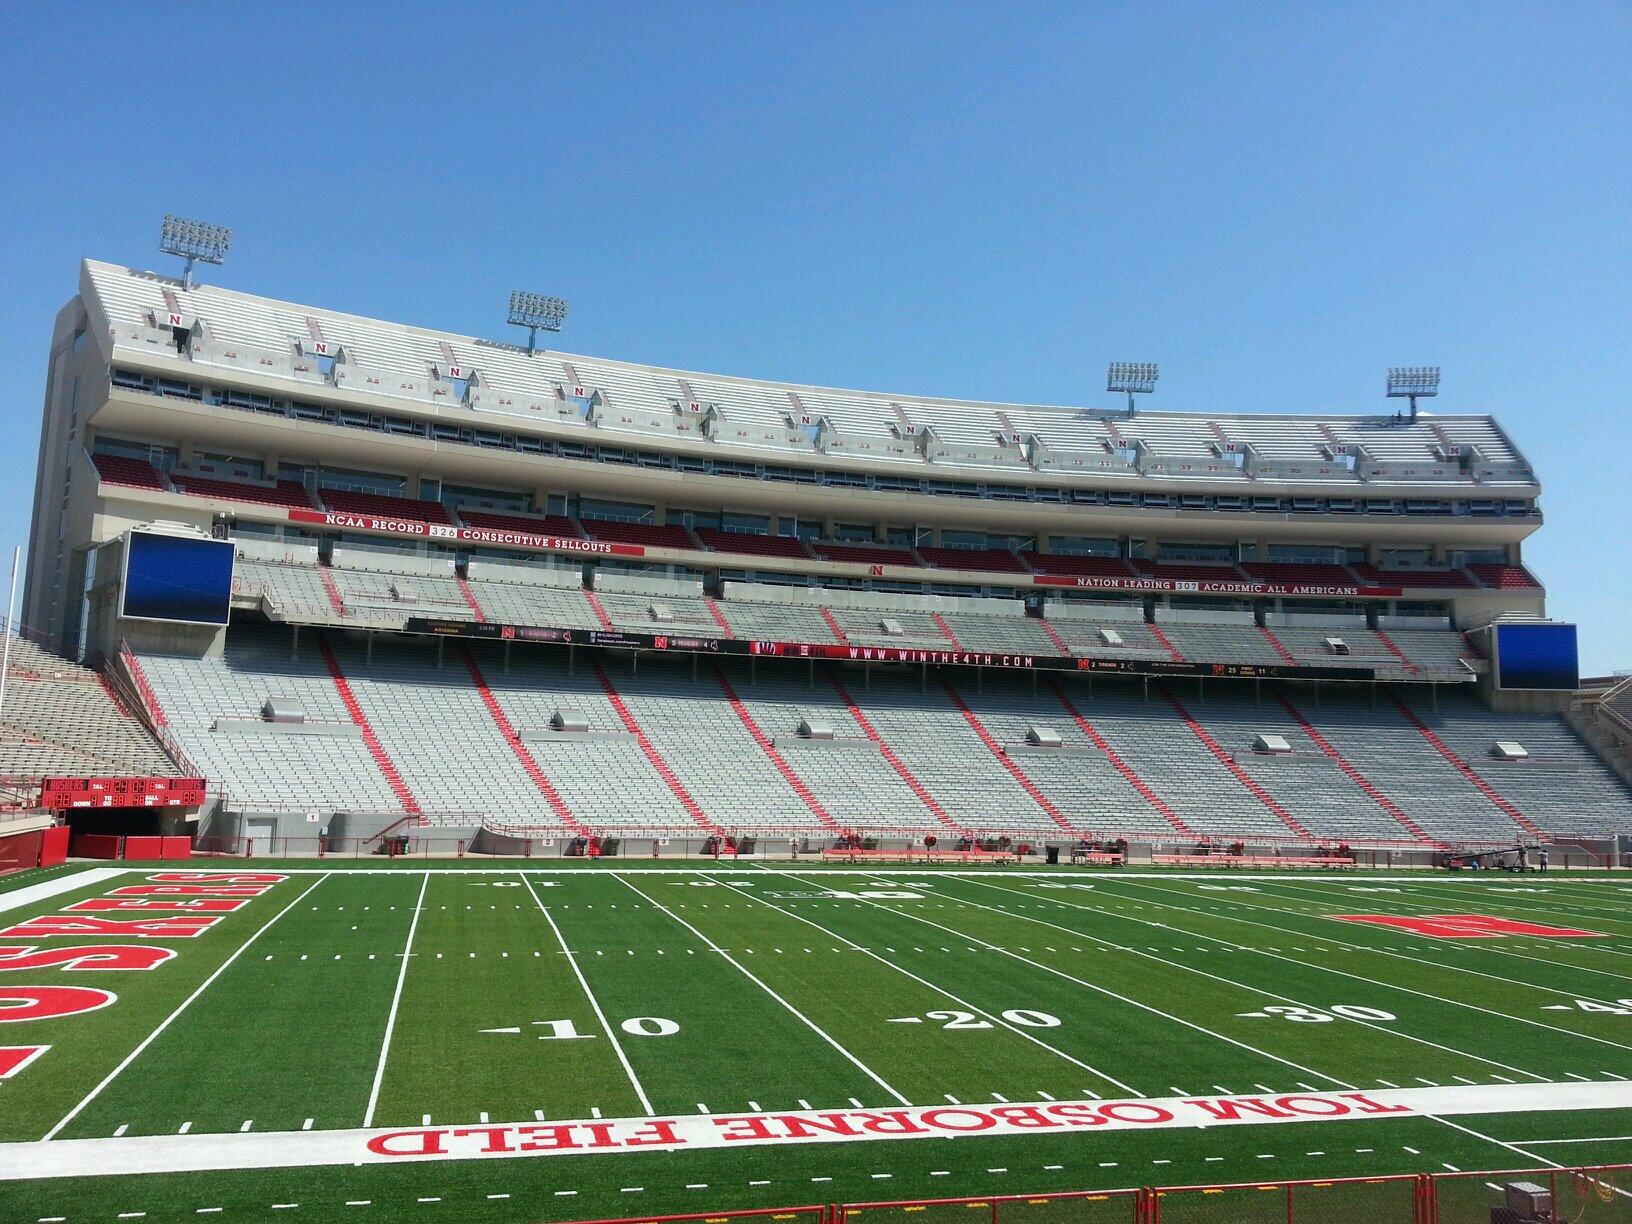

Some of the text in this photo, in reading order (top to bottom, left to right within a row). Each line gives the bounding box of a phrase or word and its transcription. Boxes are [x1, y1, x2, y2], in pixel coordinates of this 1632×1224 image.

[170, 314, 181, 325] N
[315, 343, 326, 353] N
[450, 367, 460, 377] N
[574, 386, 584, 396] N
[326, 515, 612, 553] NCAA RECORD 326 CONSECUTIVE SELLOUTS
[872, 564, 884, 576] N
[1077, 578, 1119, 588] NATION
[1124, 580, 1171, 590] LEADING
[1204, 584, 1262, 592] ACADEMIC
[1268, 586, 1287, 594] ALL
[1292, 586, 1358, 595] AMERICANS
[501, 626, 516, 639] N
[654, 636, 668, 649] N
[850, 648, 1033, 667] WWW.WINTHE4TH.COM
[0, 873, 291, 1083] SKERS
[366, 1093, 1414, 1156] TOM OSBORNE FIELD
